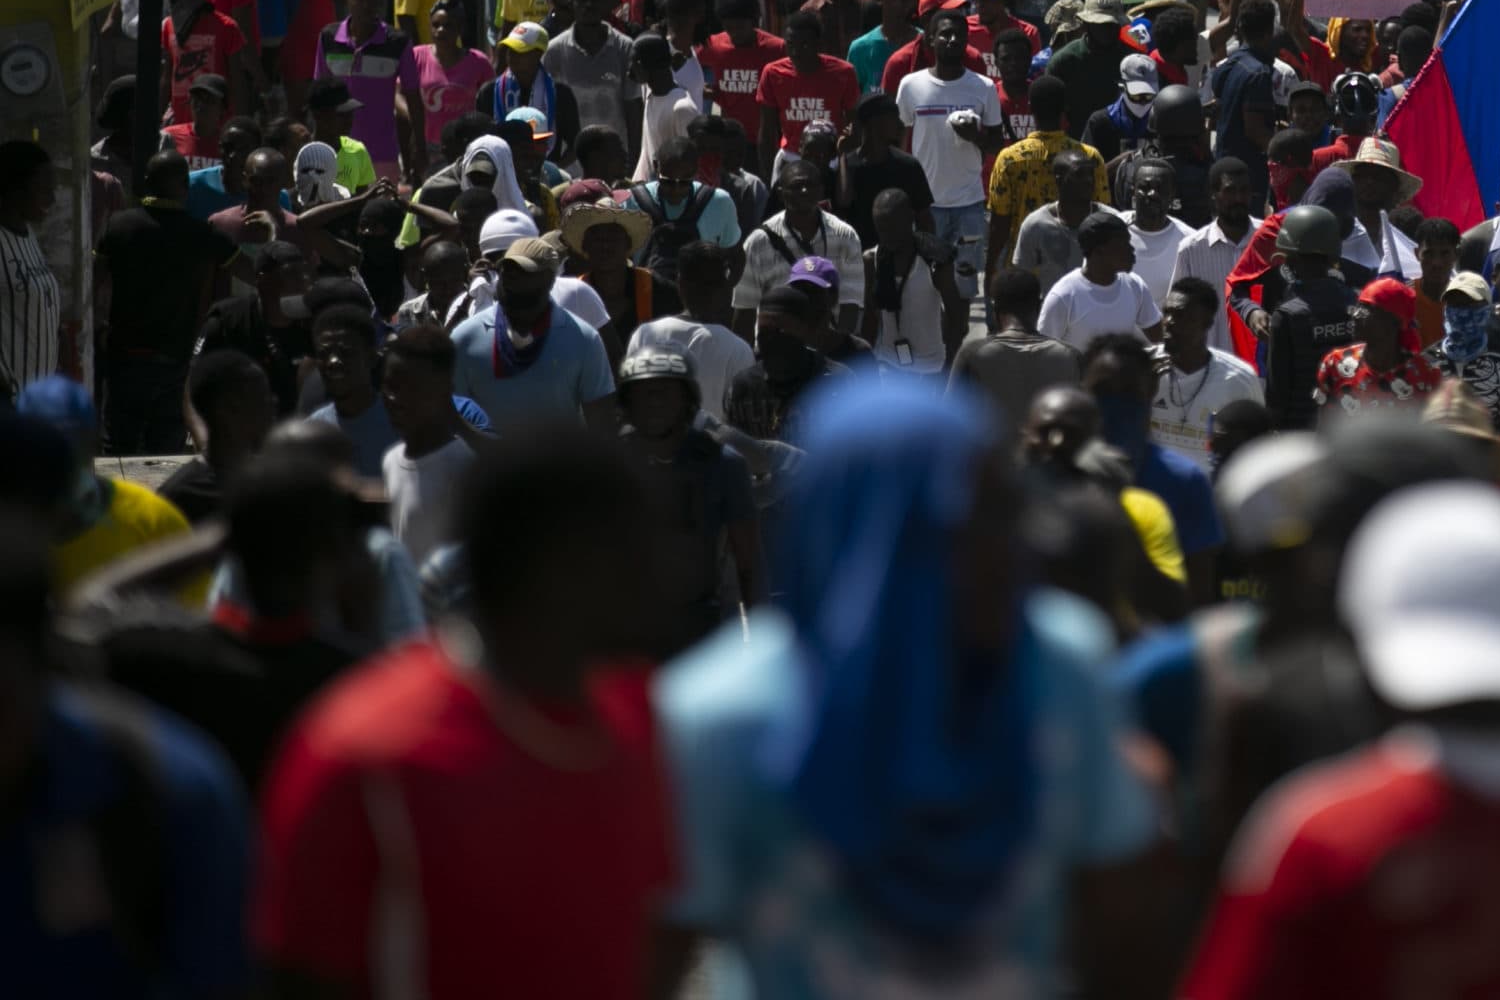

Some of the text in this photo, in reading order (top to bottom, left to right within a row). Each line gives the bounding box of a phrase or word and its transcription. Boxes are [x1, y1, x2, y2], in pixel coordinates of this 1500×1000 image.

[723, 69, 759, 82] LEVE
[719, 80, 760, 94] KANP
[790, 97, 825, 111] LEVE
[785, 109, 832, 122] KANPE
[1313, 320, 1356, 339] PRES
